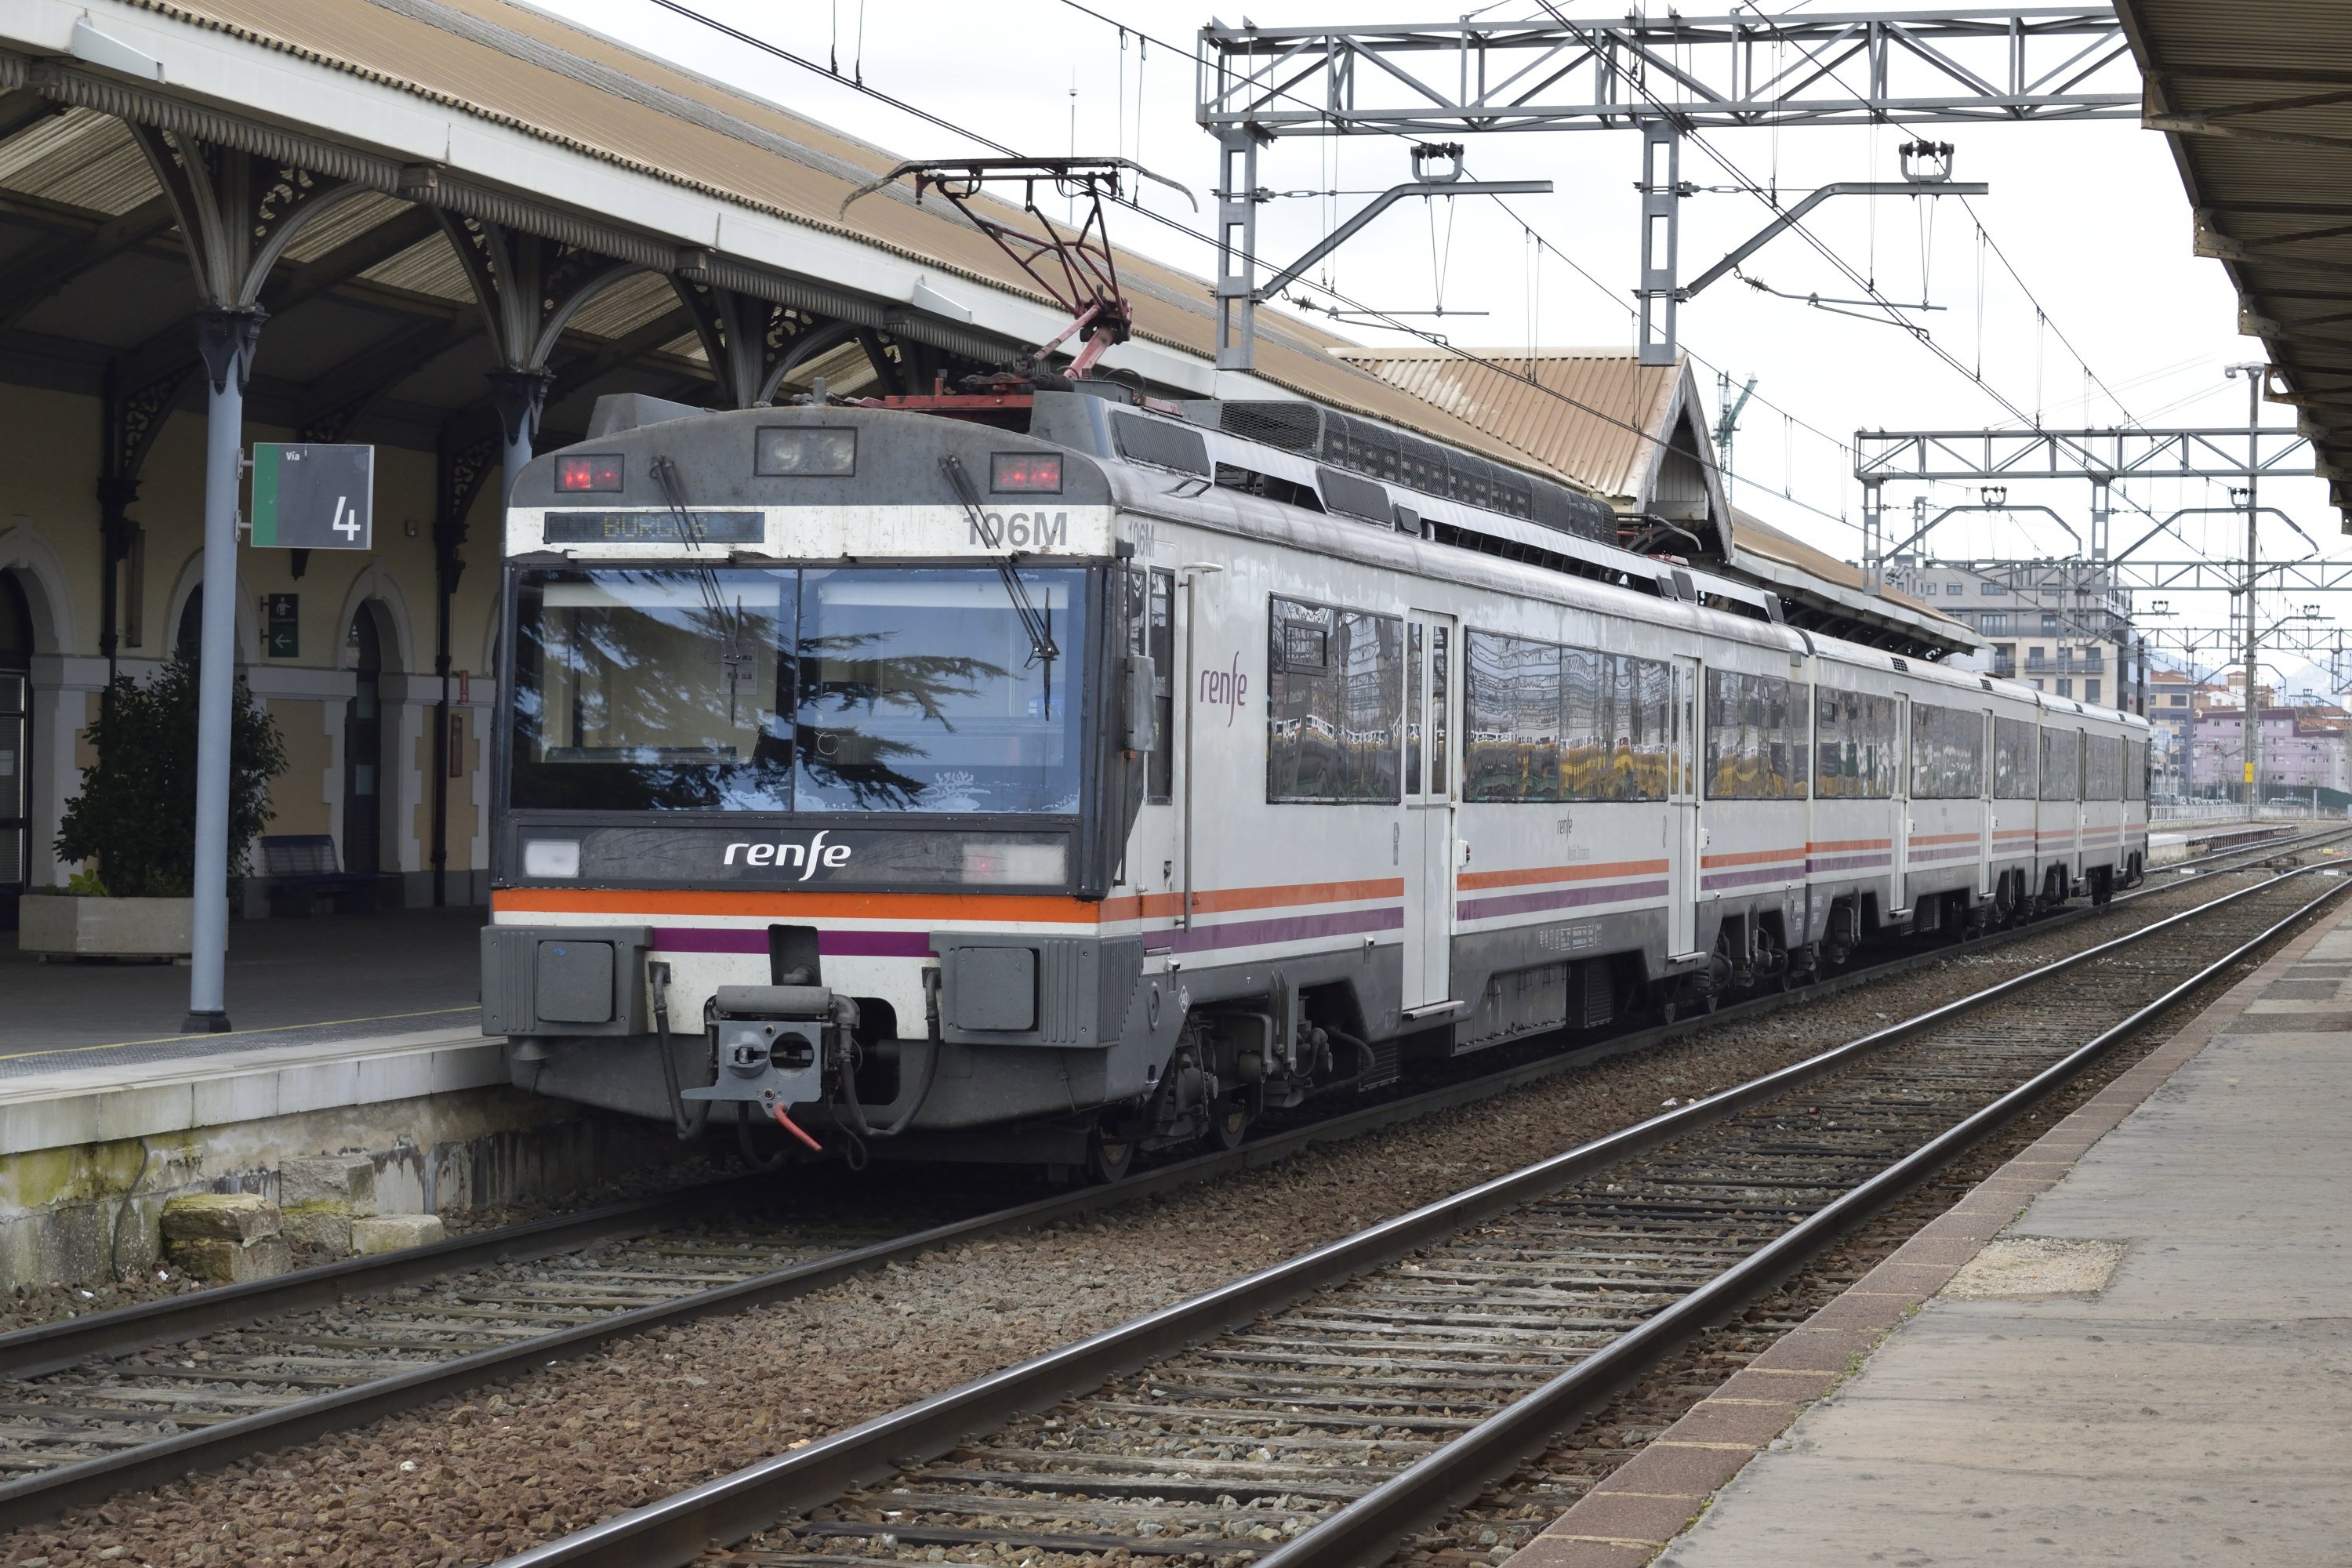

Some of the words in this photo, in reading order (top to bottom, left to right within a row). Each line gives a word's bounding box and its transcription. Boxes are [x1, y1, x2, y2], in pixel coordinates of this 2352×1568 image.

[286, 452, 300, 460] Vía
[332, 496, 361, 541] 4
[603, 515, 708, 537] BURGOS
[963, 512, 1067, 546] 106M
[1129, 520, 1155, 557] 106M
[1200, 651, 1247, 728] renfe
[1557, 809, 1573, 844] renfe
[724, 830, 851, 881] renfe
